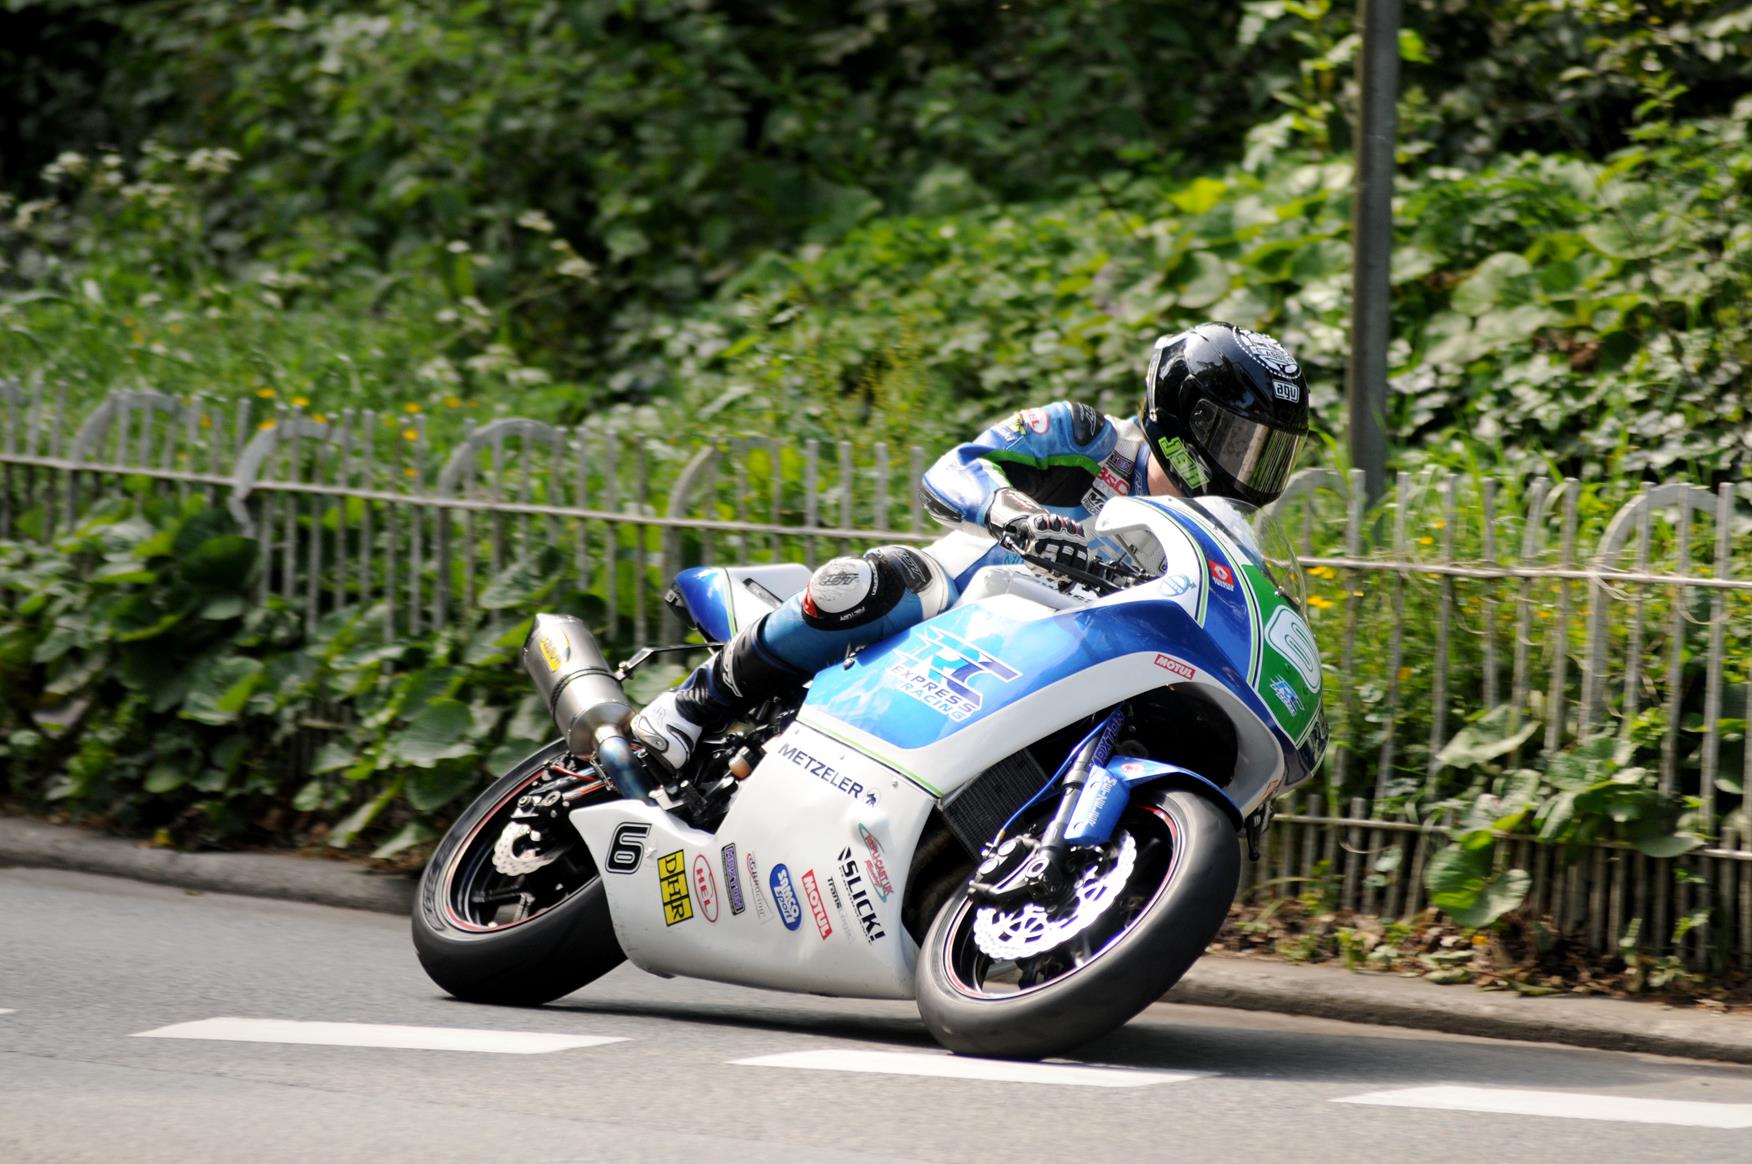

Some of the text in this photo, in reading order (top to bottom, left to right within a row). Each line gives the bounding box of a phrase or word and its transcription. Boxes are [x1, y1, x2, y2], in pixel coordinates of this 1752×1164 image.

[1276, 383, 1298, 399] agv
[891, 665, 977, 713] EXPRESS
[1155, 655, 1194, 679] MOTUL
[902, 683, 963, 720] RACING
[778, 743, 864, 799] METZELER
[605, 822, 652, 874] 6
[663, 855, 687, 921] DHR
[775, 889, 793, 919] sport
[777, 869, 800, 918] SAMCO
[804, 878, 831, 937] MOTUL
[842, 860, 885, 942] SLICK!
